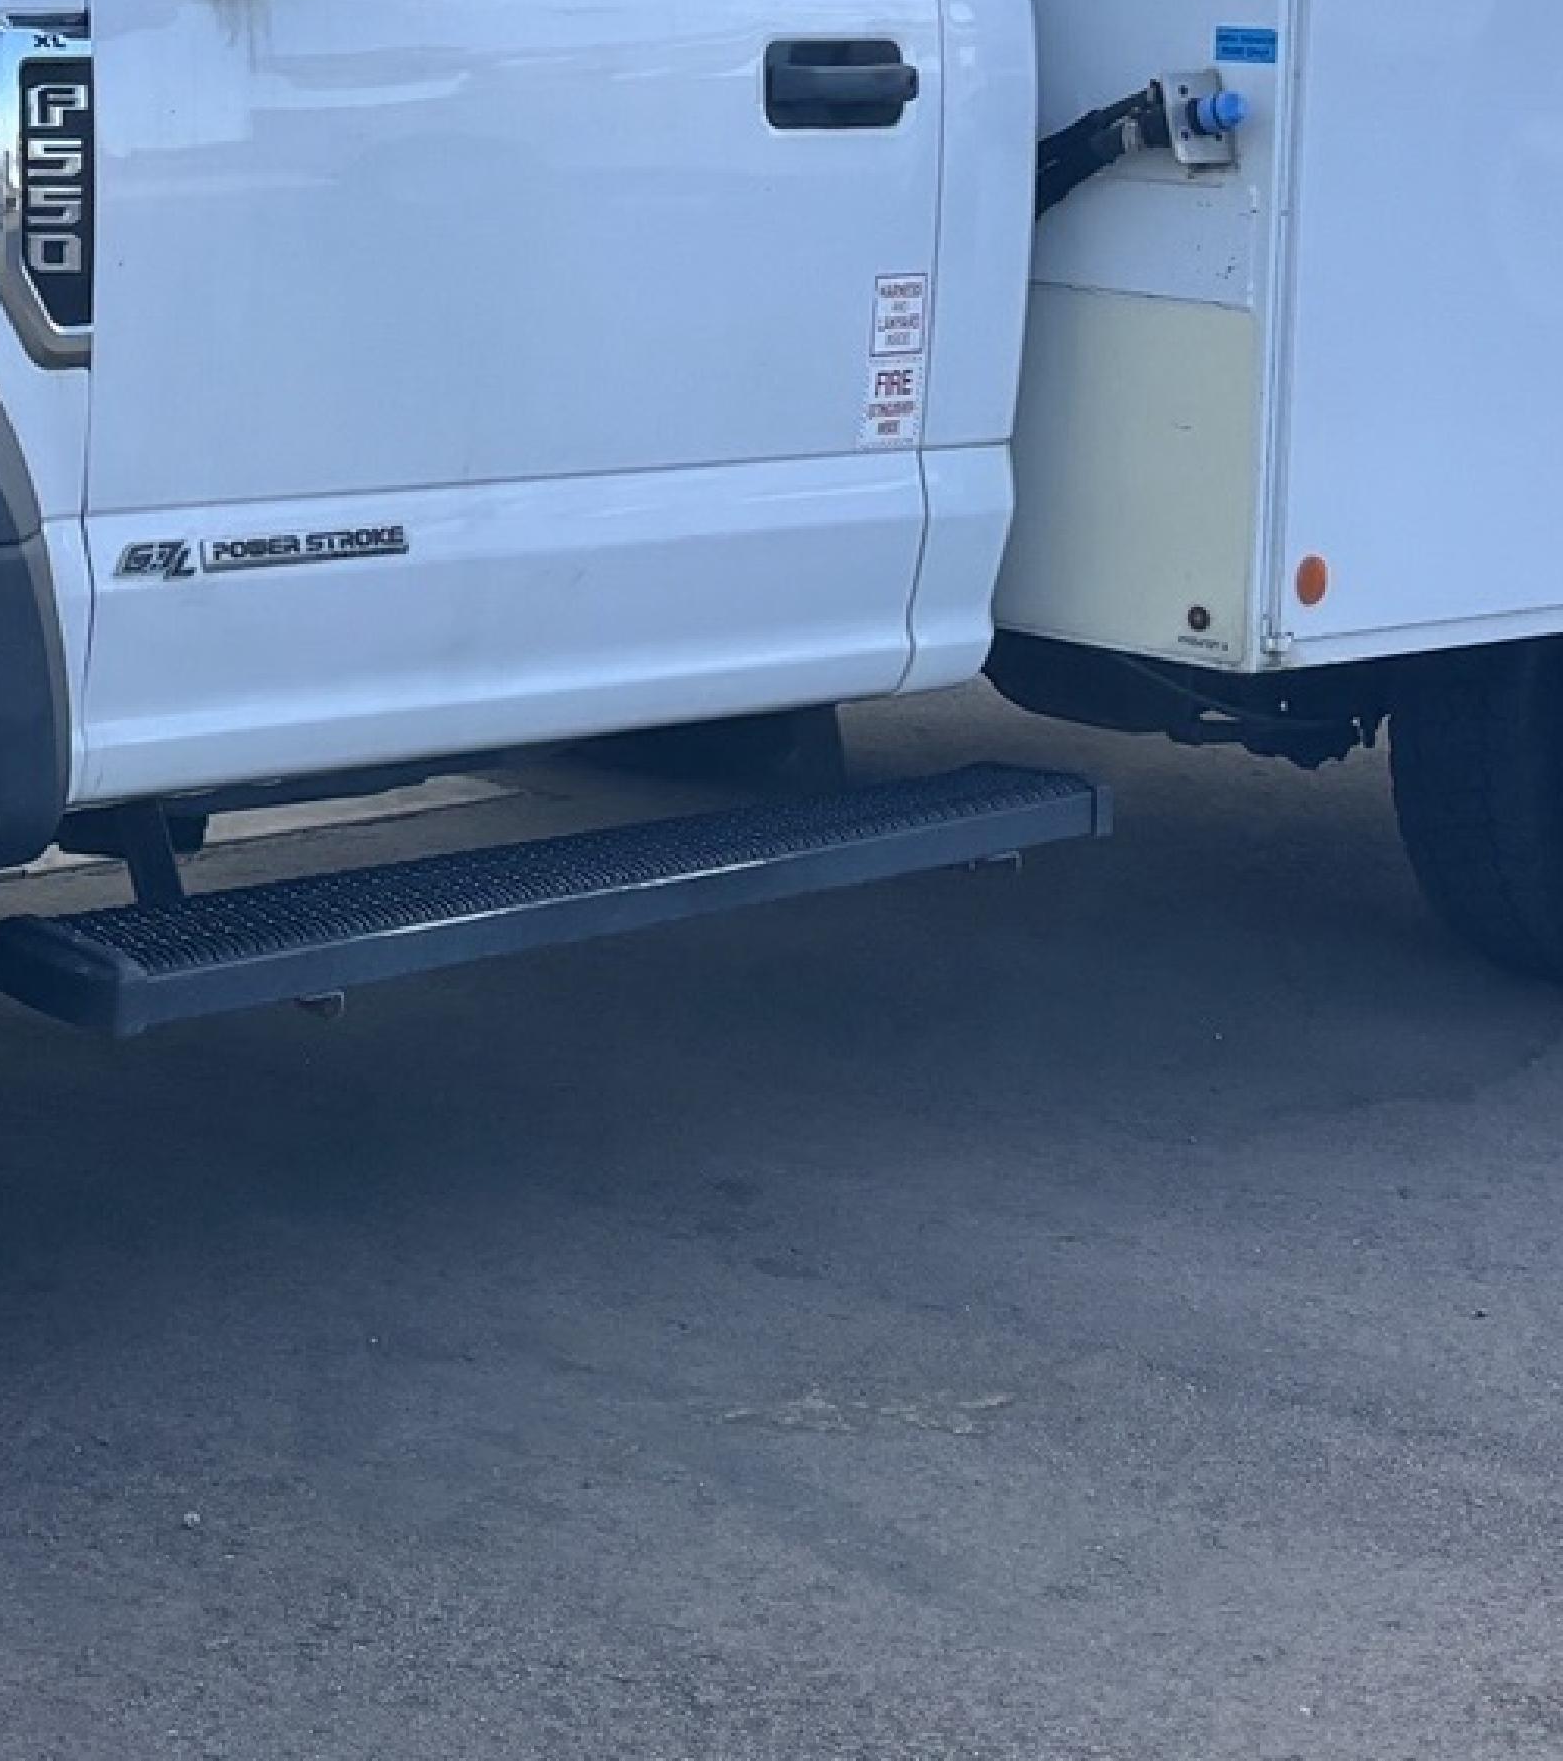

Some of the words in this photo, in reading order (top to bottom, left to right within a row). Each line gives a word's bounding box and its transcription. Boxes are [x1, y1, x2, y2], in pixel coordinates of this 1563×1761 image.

[33, 34, 66, 48] XL
[874, 369, 914, 398] FIRE
[211, 534, 301, 561] POWER
[305, 525, 404, 552] STROKE
